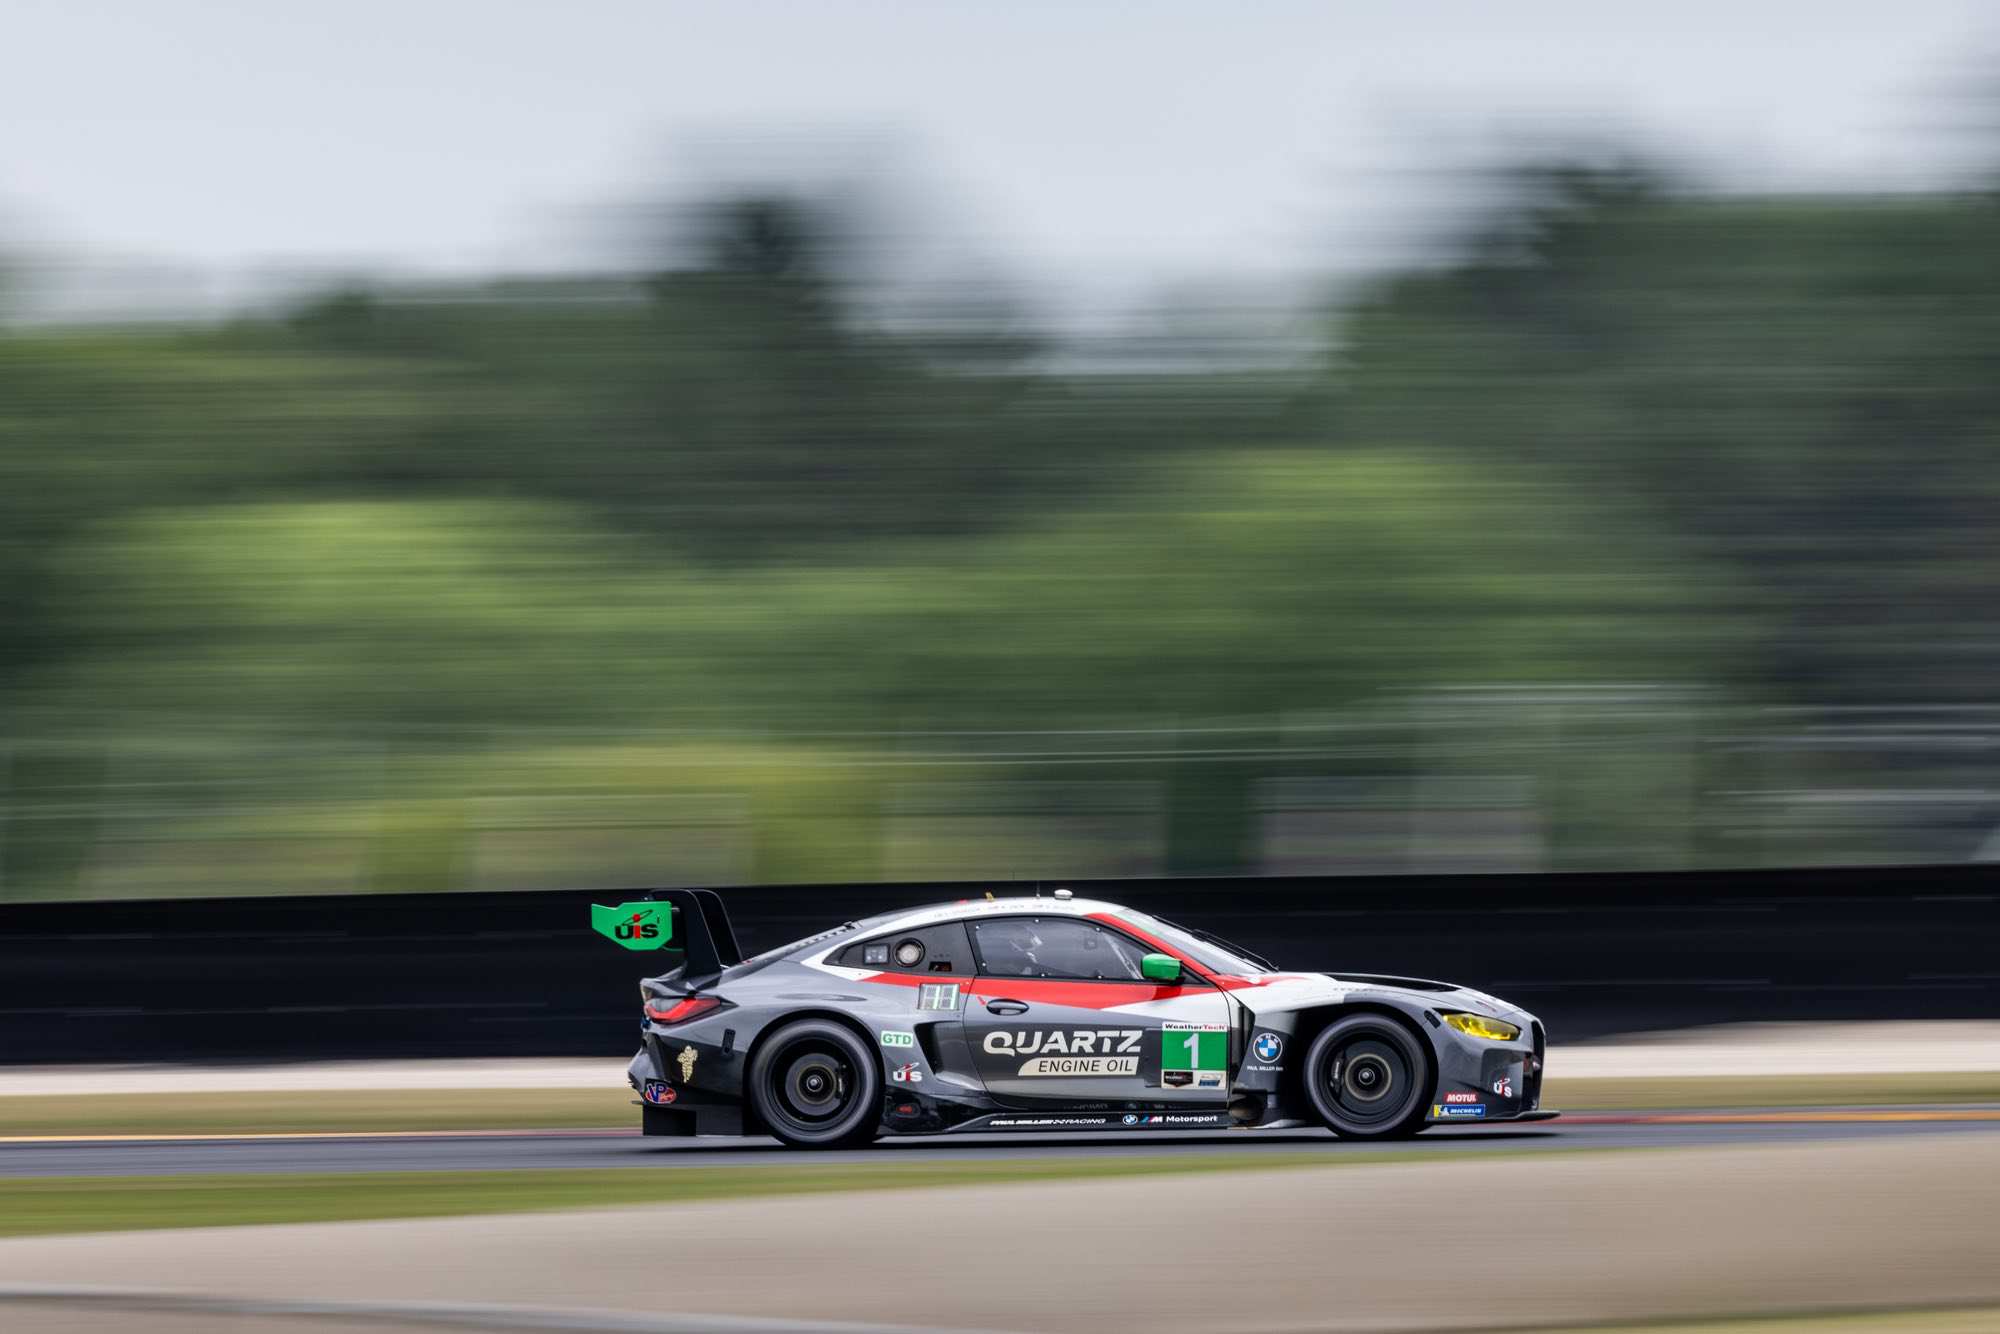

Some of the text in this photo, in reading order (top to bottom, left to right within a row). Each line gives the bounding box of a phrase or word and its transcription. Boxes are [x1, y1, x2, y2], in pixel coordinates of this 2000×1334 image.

[882, 1033, 912, 1045] GTD
[983, 1030, 1143, 1057] QUARTZ
[1183, 1032, 1200, 1069] 1
[1038, 1059, 1133, 1073] ENGINE OIL
[1446, 1093, 1477, 1103] MOTUL
[1166, 1115, 1218, 1124] Motorsport
